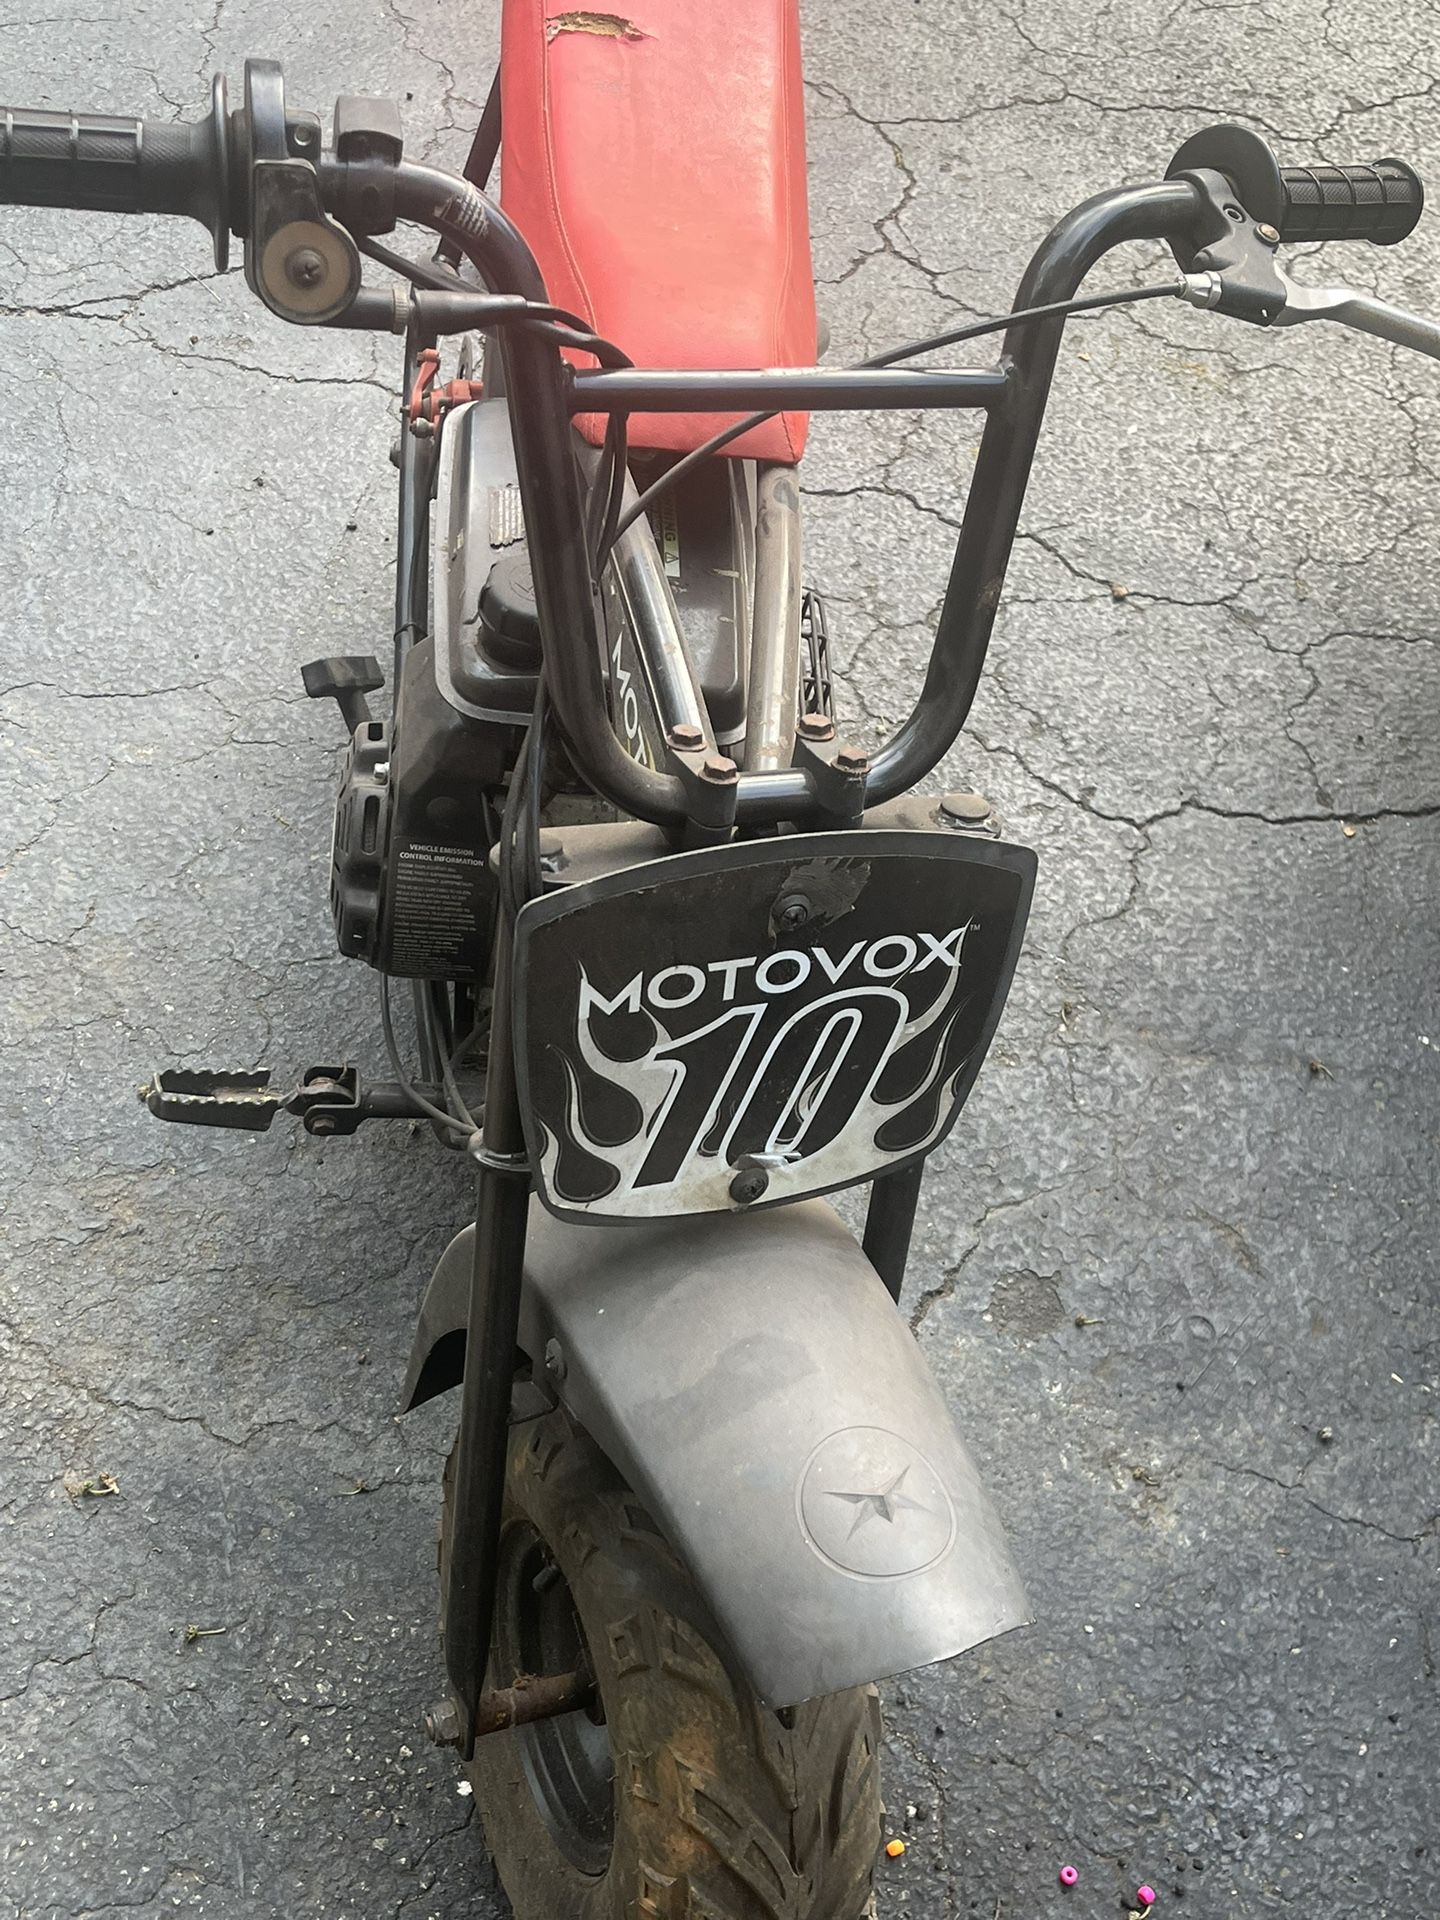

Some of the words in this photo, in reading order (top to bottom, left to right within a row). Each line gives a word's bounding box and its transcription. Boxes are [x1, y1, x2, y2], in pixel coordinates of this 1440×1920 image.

[399, 851, 433, 861] CONTROL
[434, 855, 485, 867] INFORMATION
[409, 843, 438, 853] VEHICLE
[439, 846, 475, 857] EMISSION
[580, 927, 968, 1019] MOTOVOX
[632, 986, 909, 1191] 10
